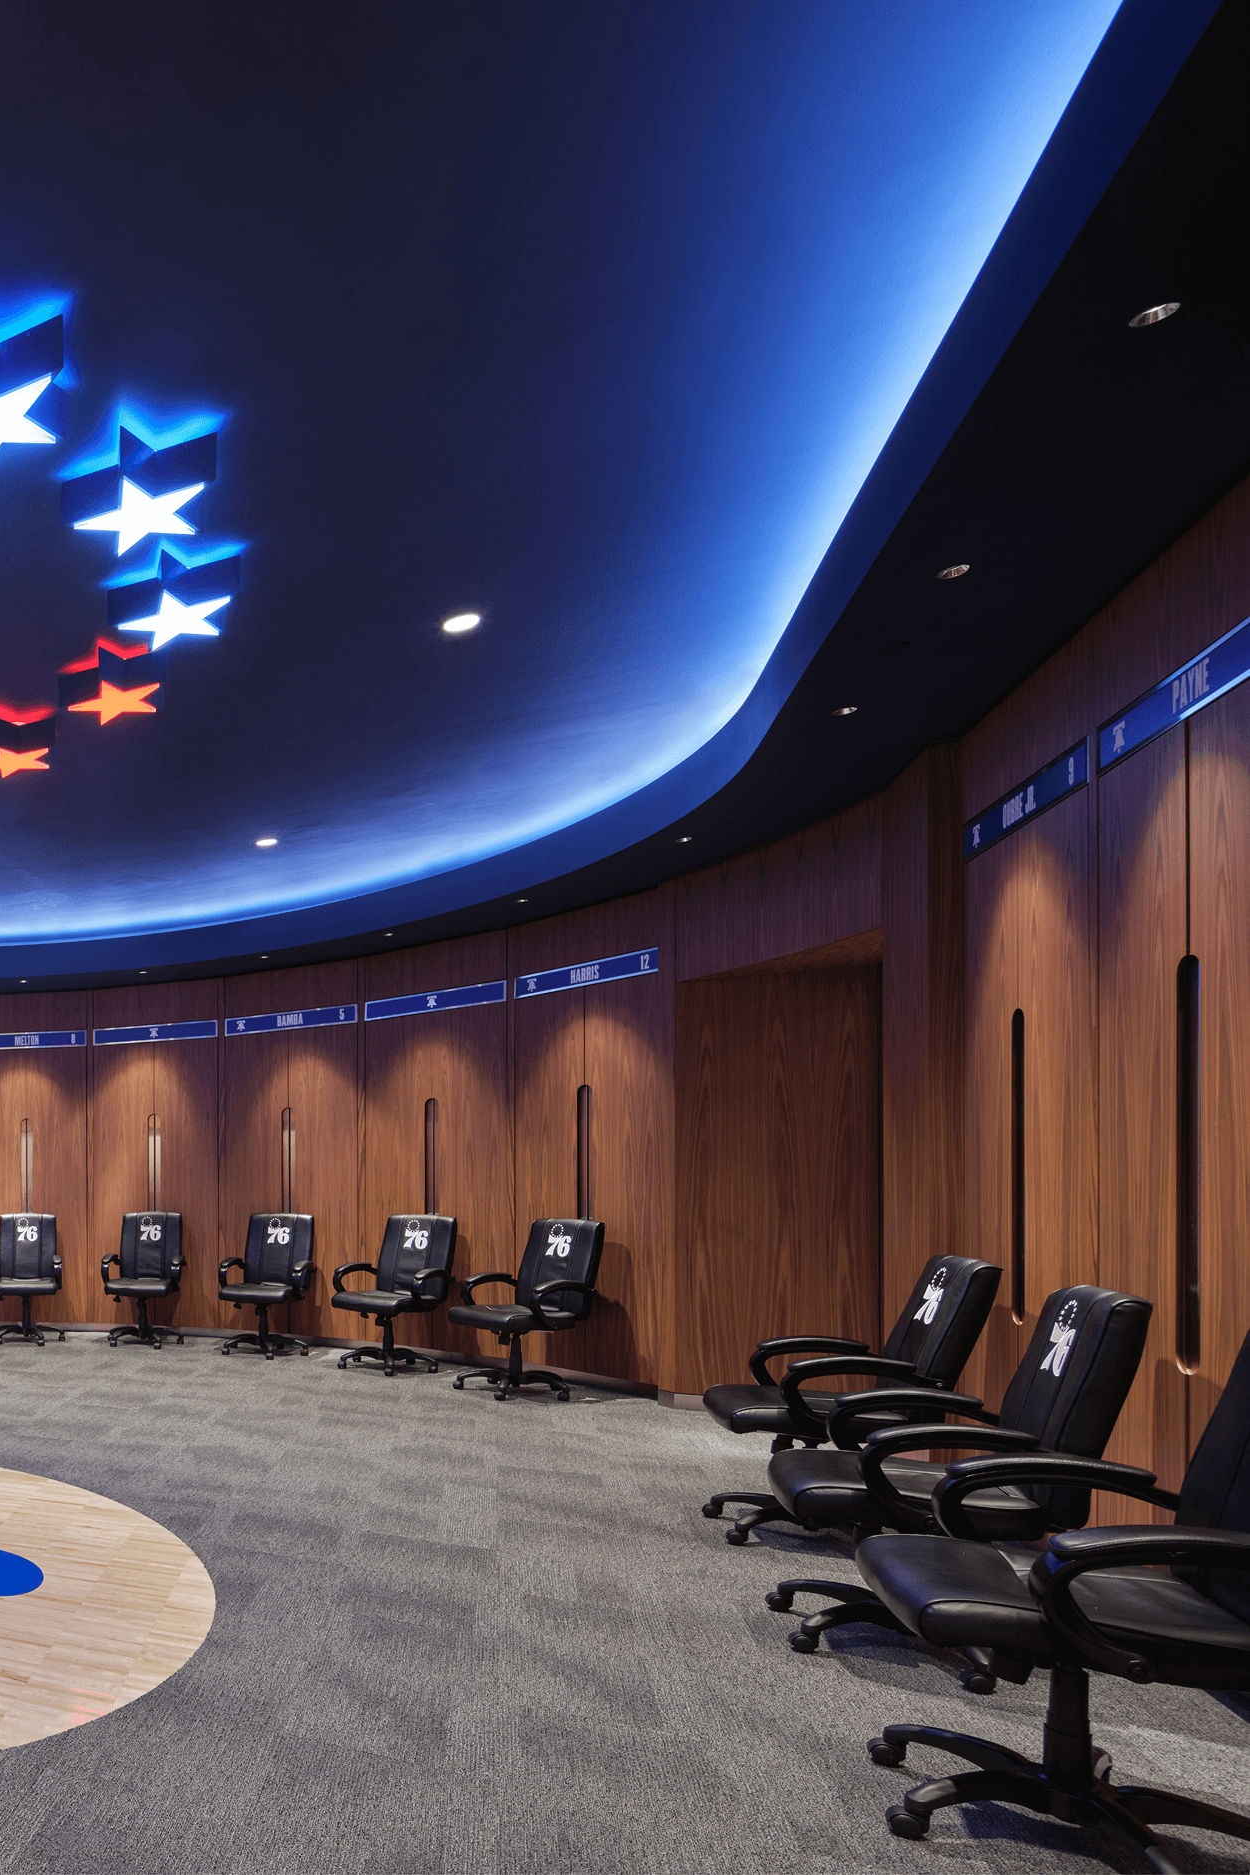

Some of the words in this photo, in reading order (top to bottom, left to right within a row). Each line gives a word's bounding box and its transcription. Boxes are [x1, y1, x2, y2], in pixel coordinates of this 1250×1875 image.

[1171, 656, 1210, 714] PAYNE
[1067, 756, 1074, 785] 9
[570, 964, 600, 985] HARRIS
[640, 954, 650, 971] 12
[276, 1012, 304, 1028] BAMBA
[338, 1008, 345, 1021] 5
[14, 1034, 39, 1047] MELTON
[16, 1225, 38, 1242] 76
[139, 1224, 162, 1242] 76
[266, 1226, 291, 1245] 76
[402, 1229, 429, 1250] 76
[544, 1235, 572, 1258] 76
[912, 1283, 944, 1325] 76
[1039, 1321, 1077, 1377] 76
